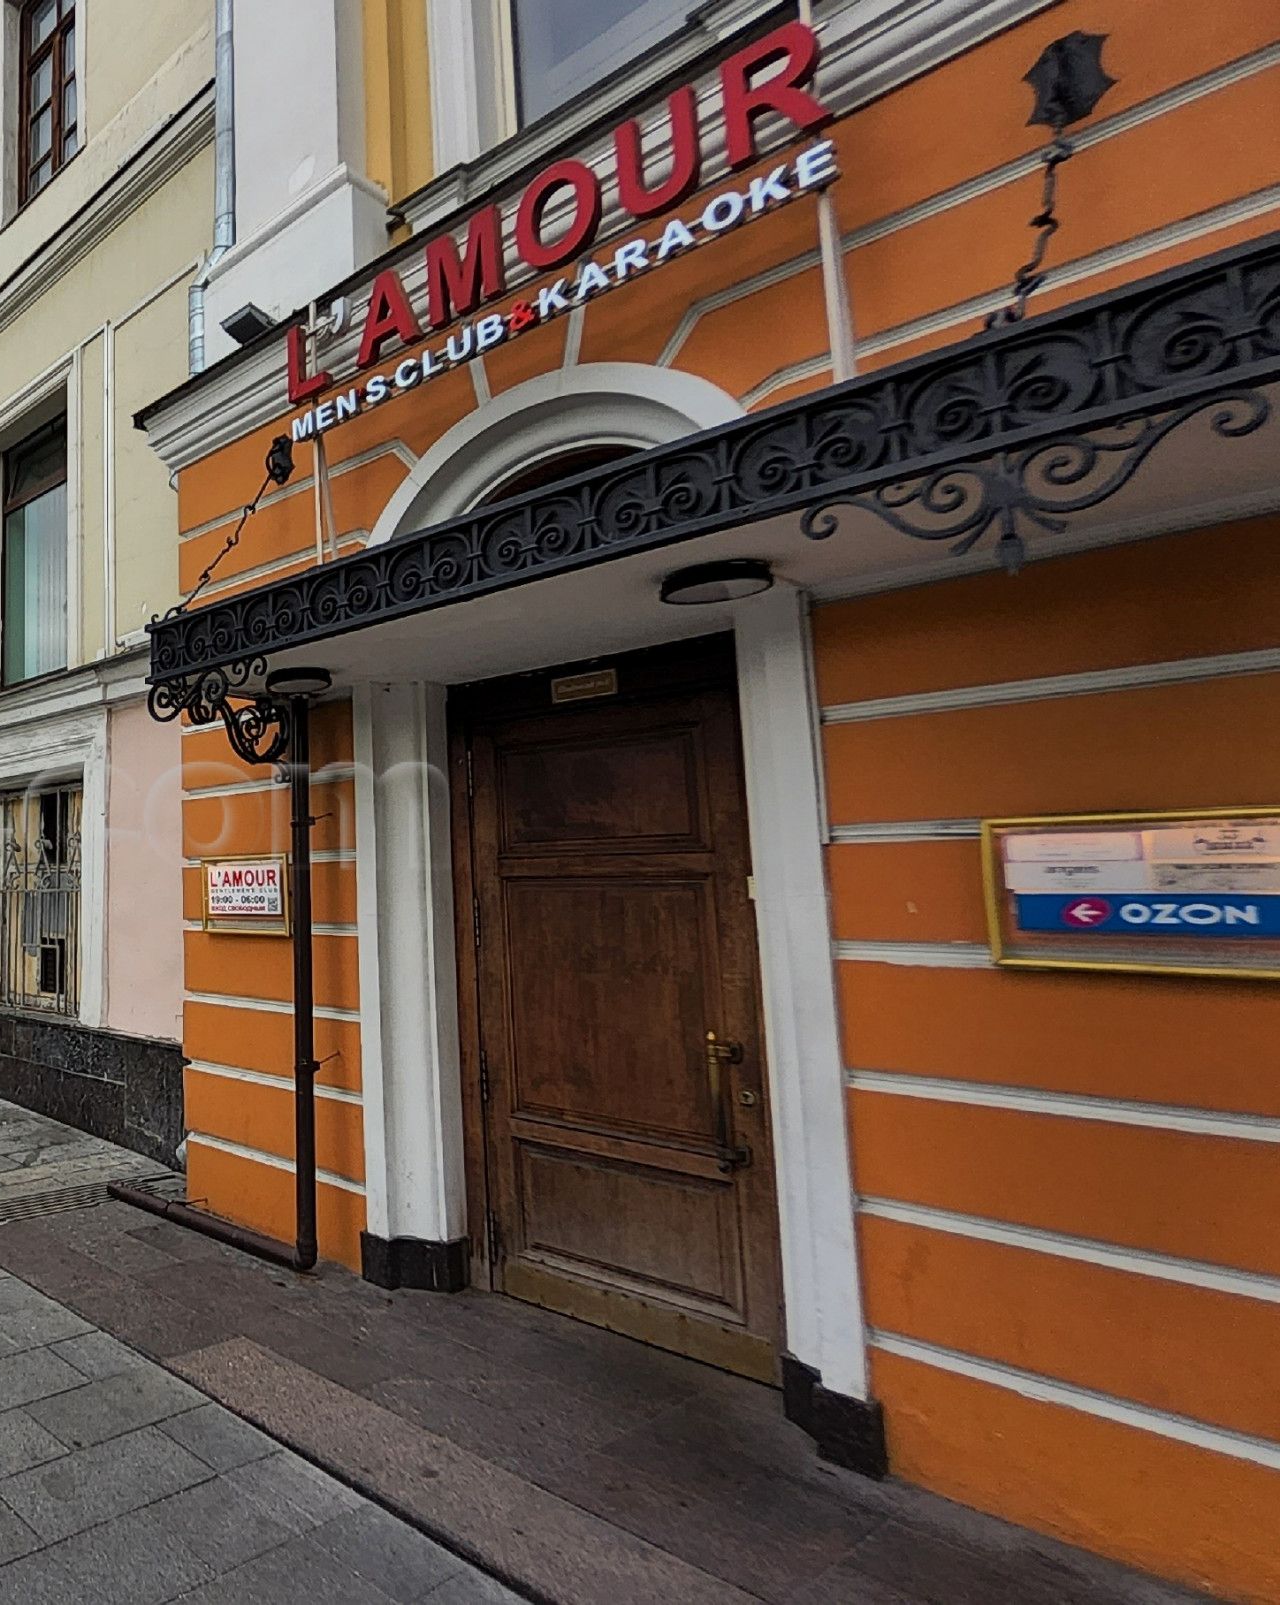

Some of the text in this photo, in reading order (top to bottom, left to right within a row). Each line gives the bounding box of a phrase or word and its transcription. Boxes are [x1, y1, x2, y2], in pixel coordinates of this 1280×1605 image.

[287, 21, 835, 404] L'AMOUR
[210, 869, 277, 887] L'AMOUR
[1120, 903, 1260, 925] OZON
